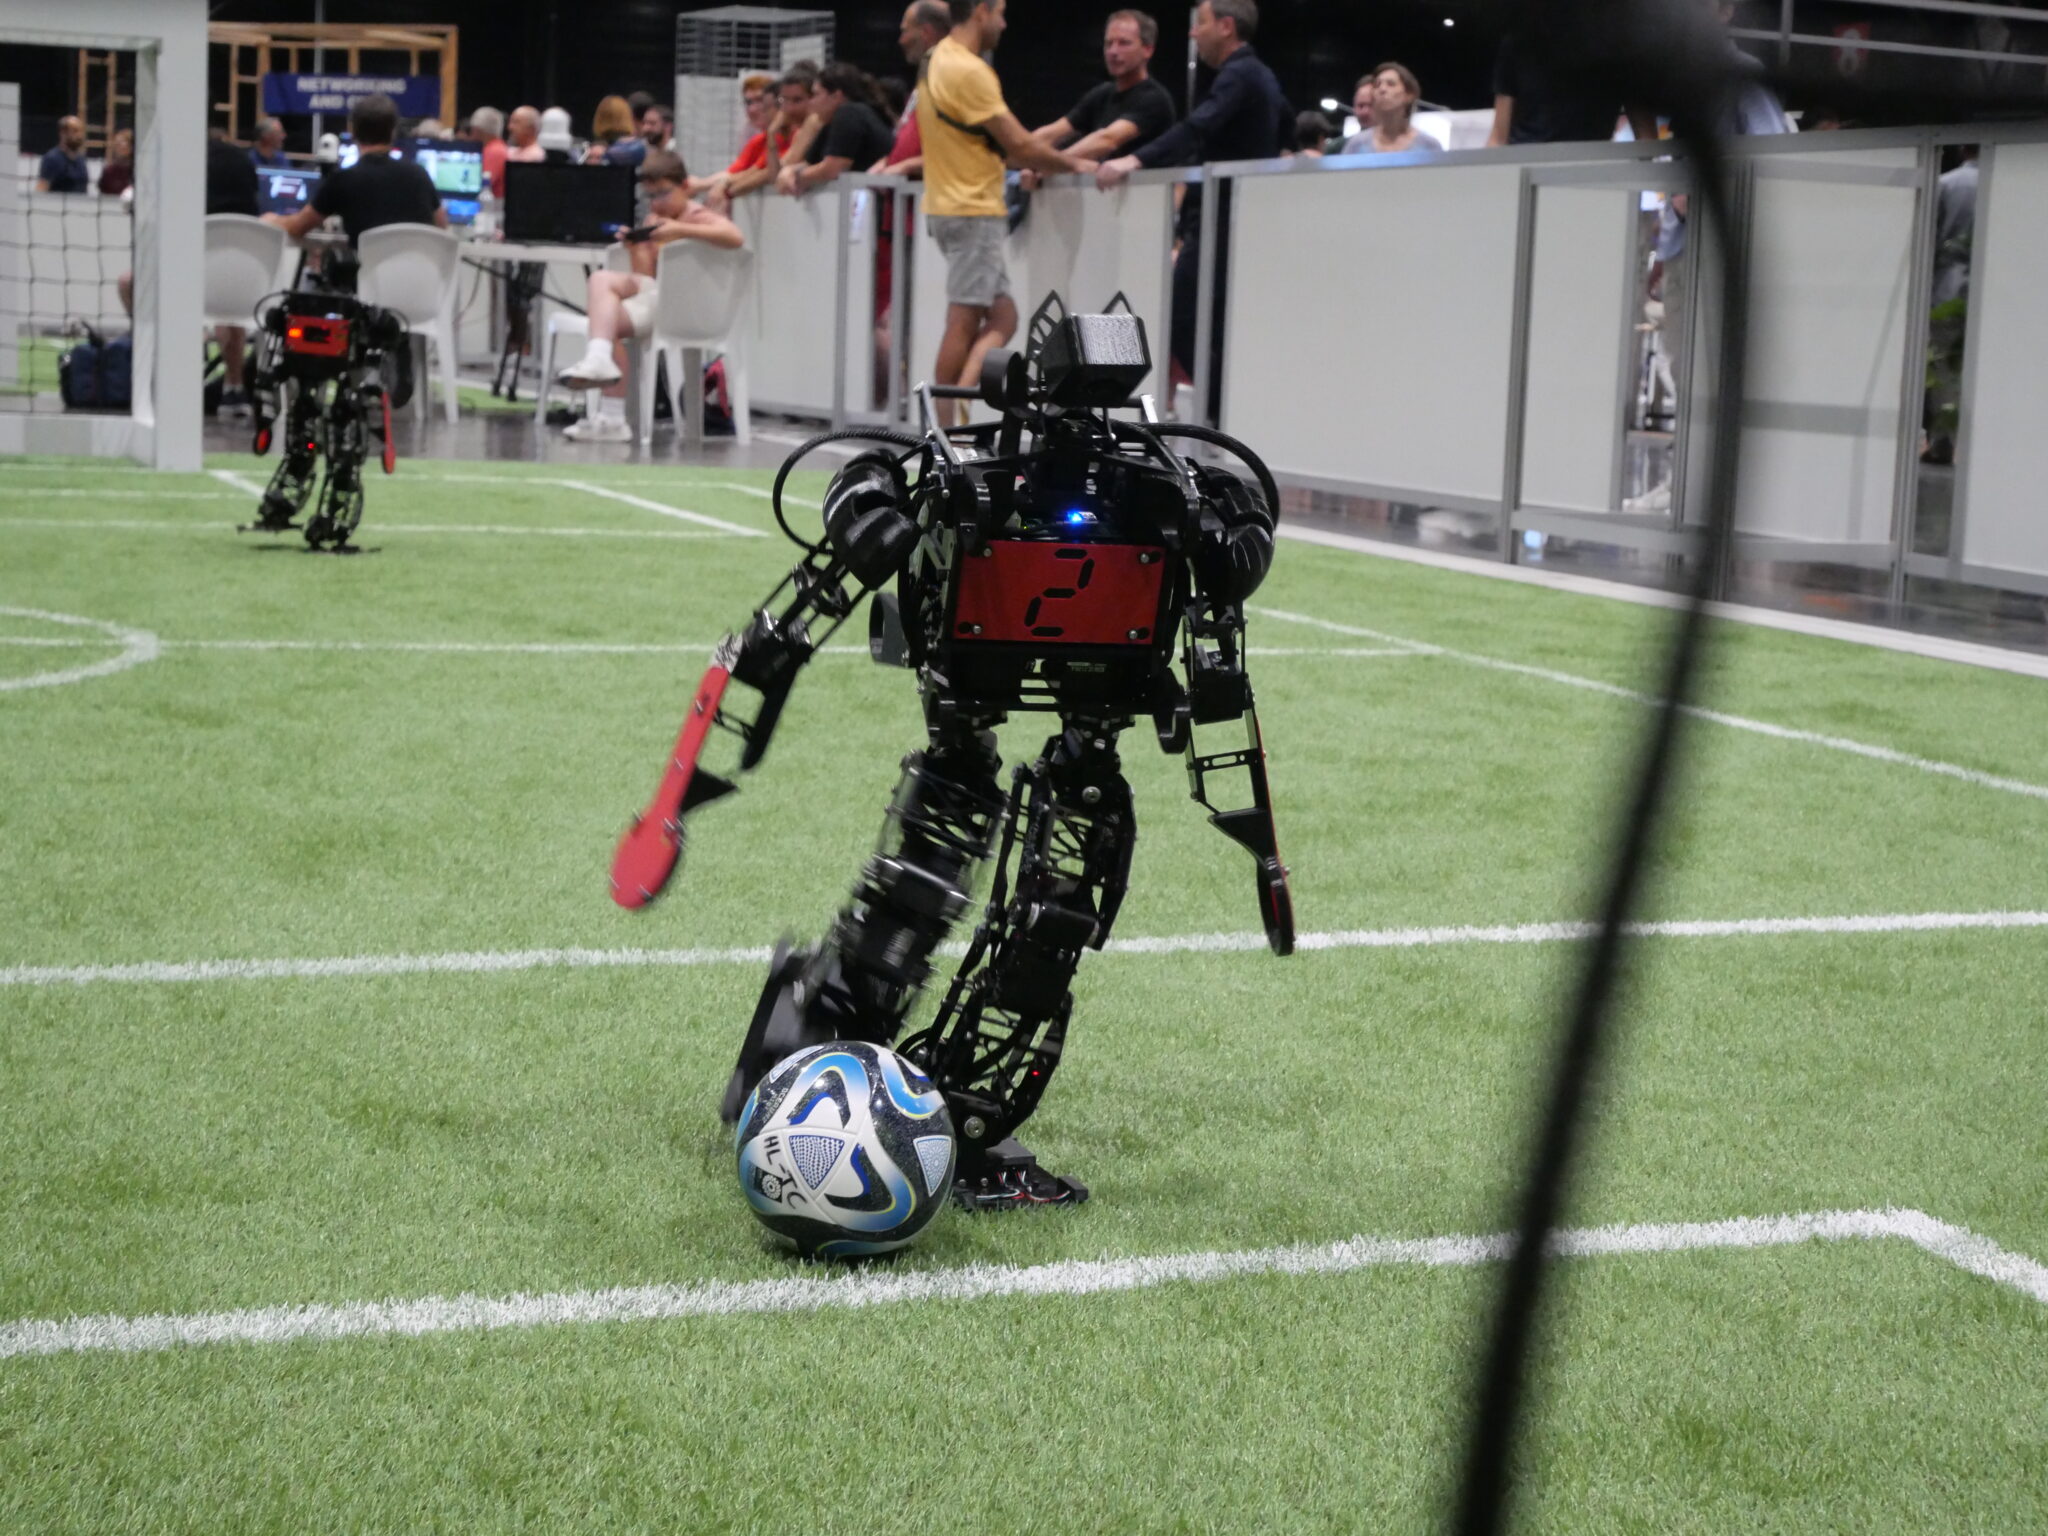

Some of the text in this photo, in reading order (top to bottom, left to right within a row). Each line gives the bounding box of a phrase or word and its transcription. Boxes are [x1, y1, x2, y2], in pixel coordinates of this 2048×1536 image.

[297, 76, 407, 94] NETWORKING
[308, 94, 345, 109] AND
[1024, 548, 1095, 637] 2
